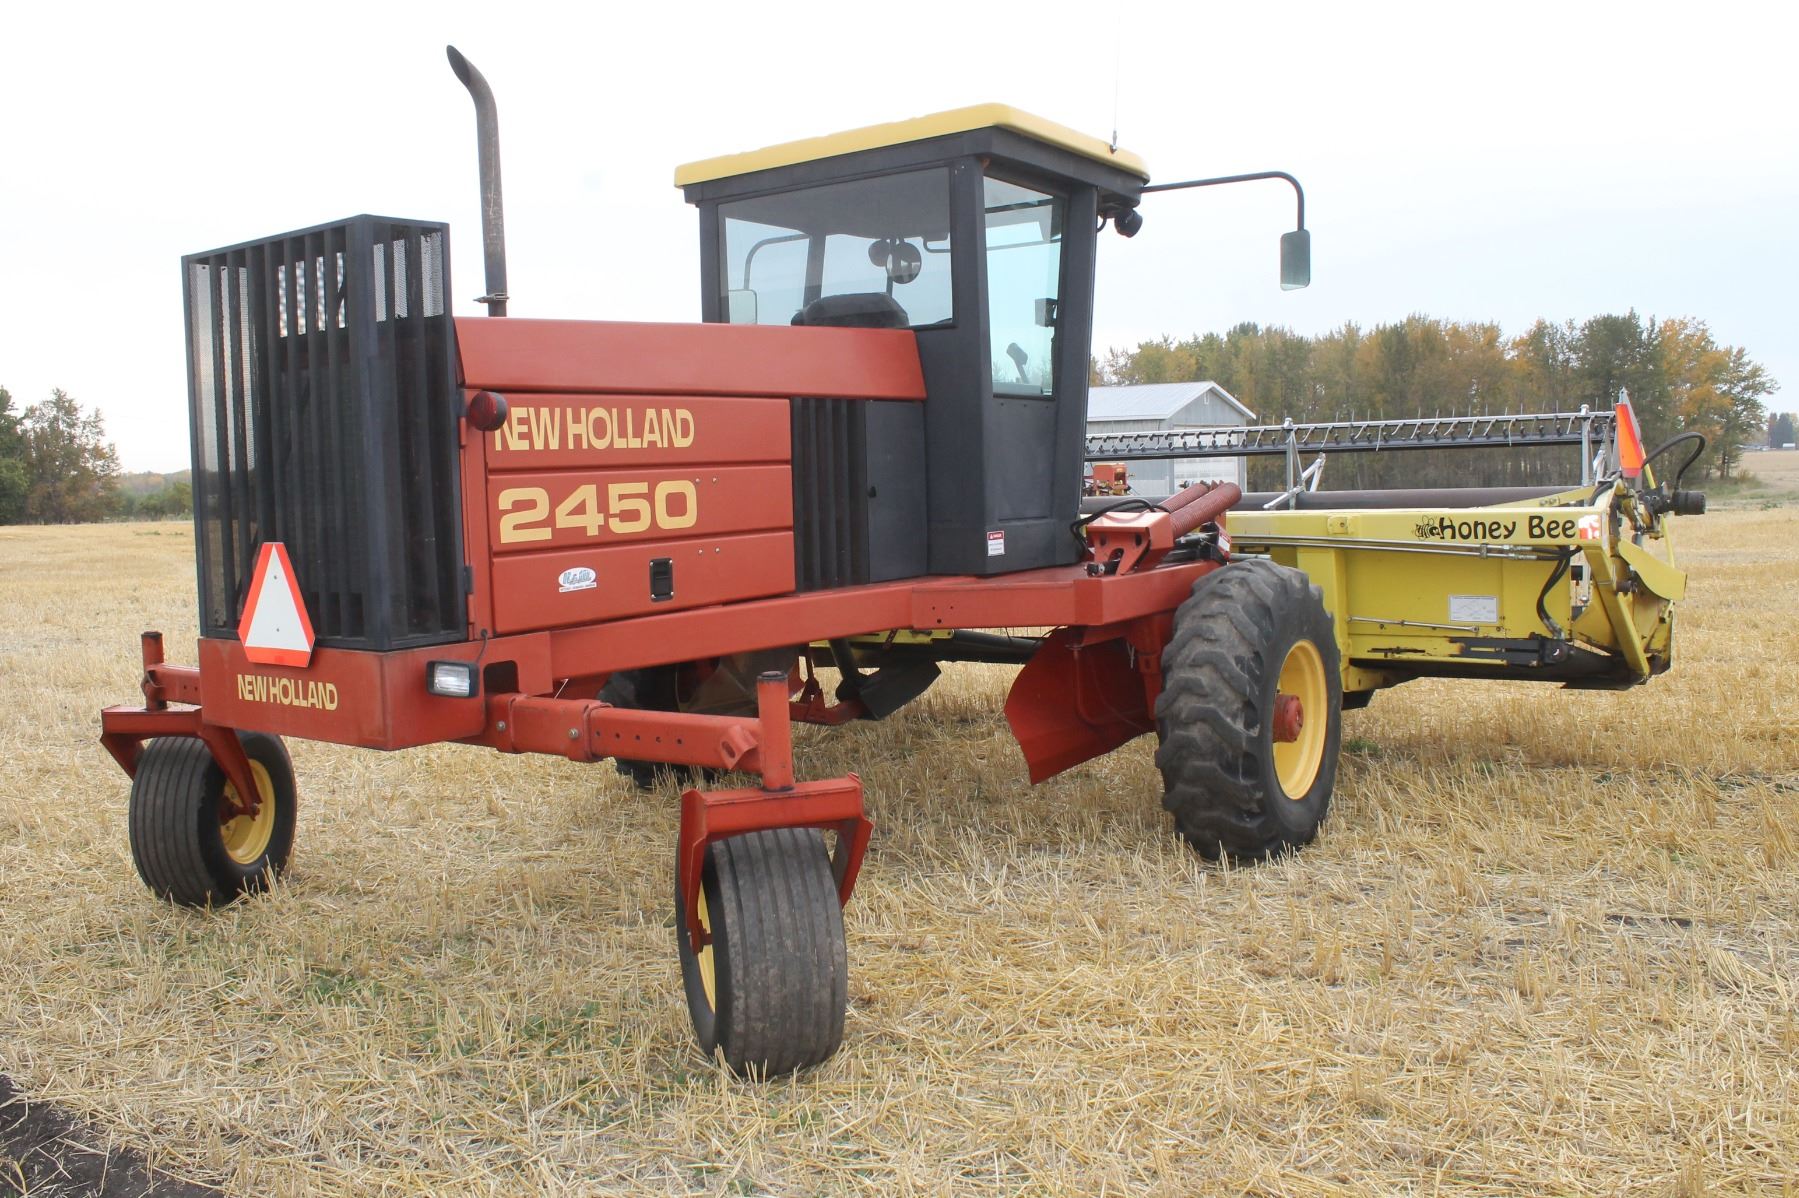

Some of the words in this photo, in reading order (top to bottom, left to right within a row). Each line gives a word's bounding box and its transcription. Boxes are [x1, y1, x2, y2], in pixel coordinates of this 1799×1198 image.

[566, 407, 695, 450] HOLLAND
[498, 480, 698, 544] 2450
[1438, 516, 1516, 540] Honey
[1528, 515, 1576, 539] Bee
[237, 673, 267, 703] NEW
[268, 676, 338, 711] HOLLAND
